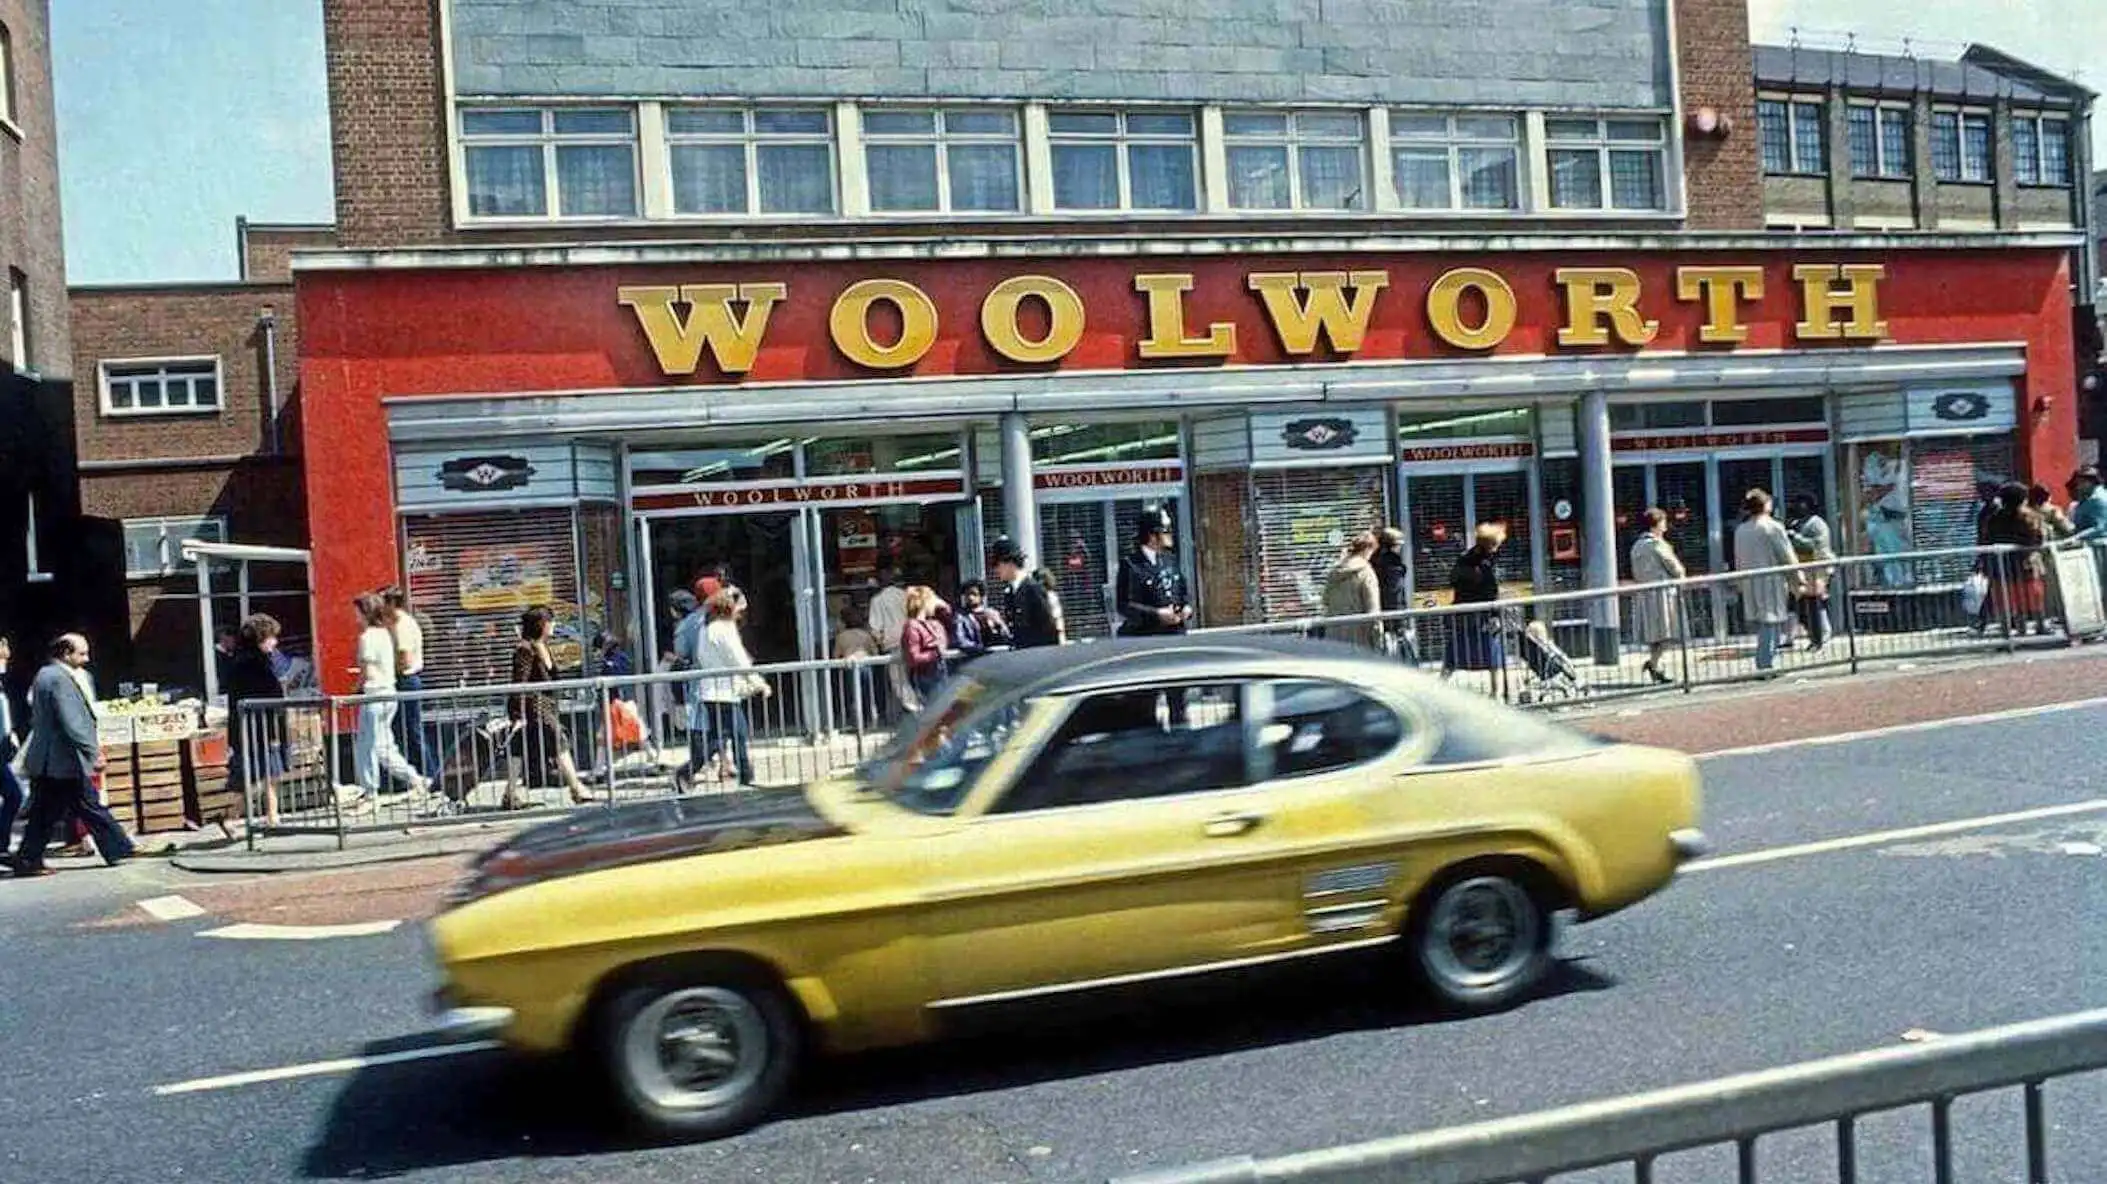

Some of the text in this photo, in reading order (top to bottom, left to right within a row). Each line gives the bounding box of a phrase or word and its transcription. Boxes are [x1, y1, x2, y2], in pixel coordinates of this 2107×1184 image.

[617, 263, 1888, 376] WOOLWORTH
[477, 467, 497, 481] W
[1045, 467, 1169, 487] WOOLWORTH
[694, 482, 903, 507] WOOLWORTH
